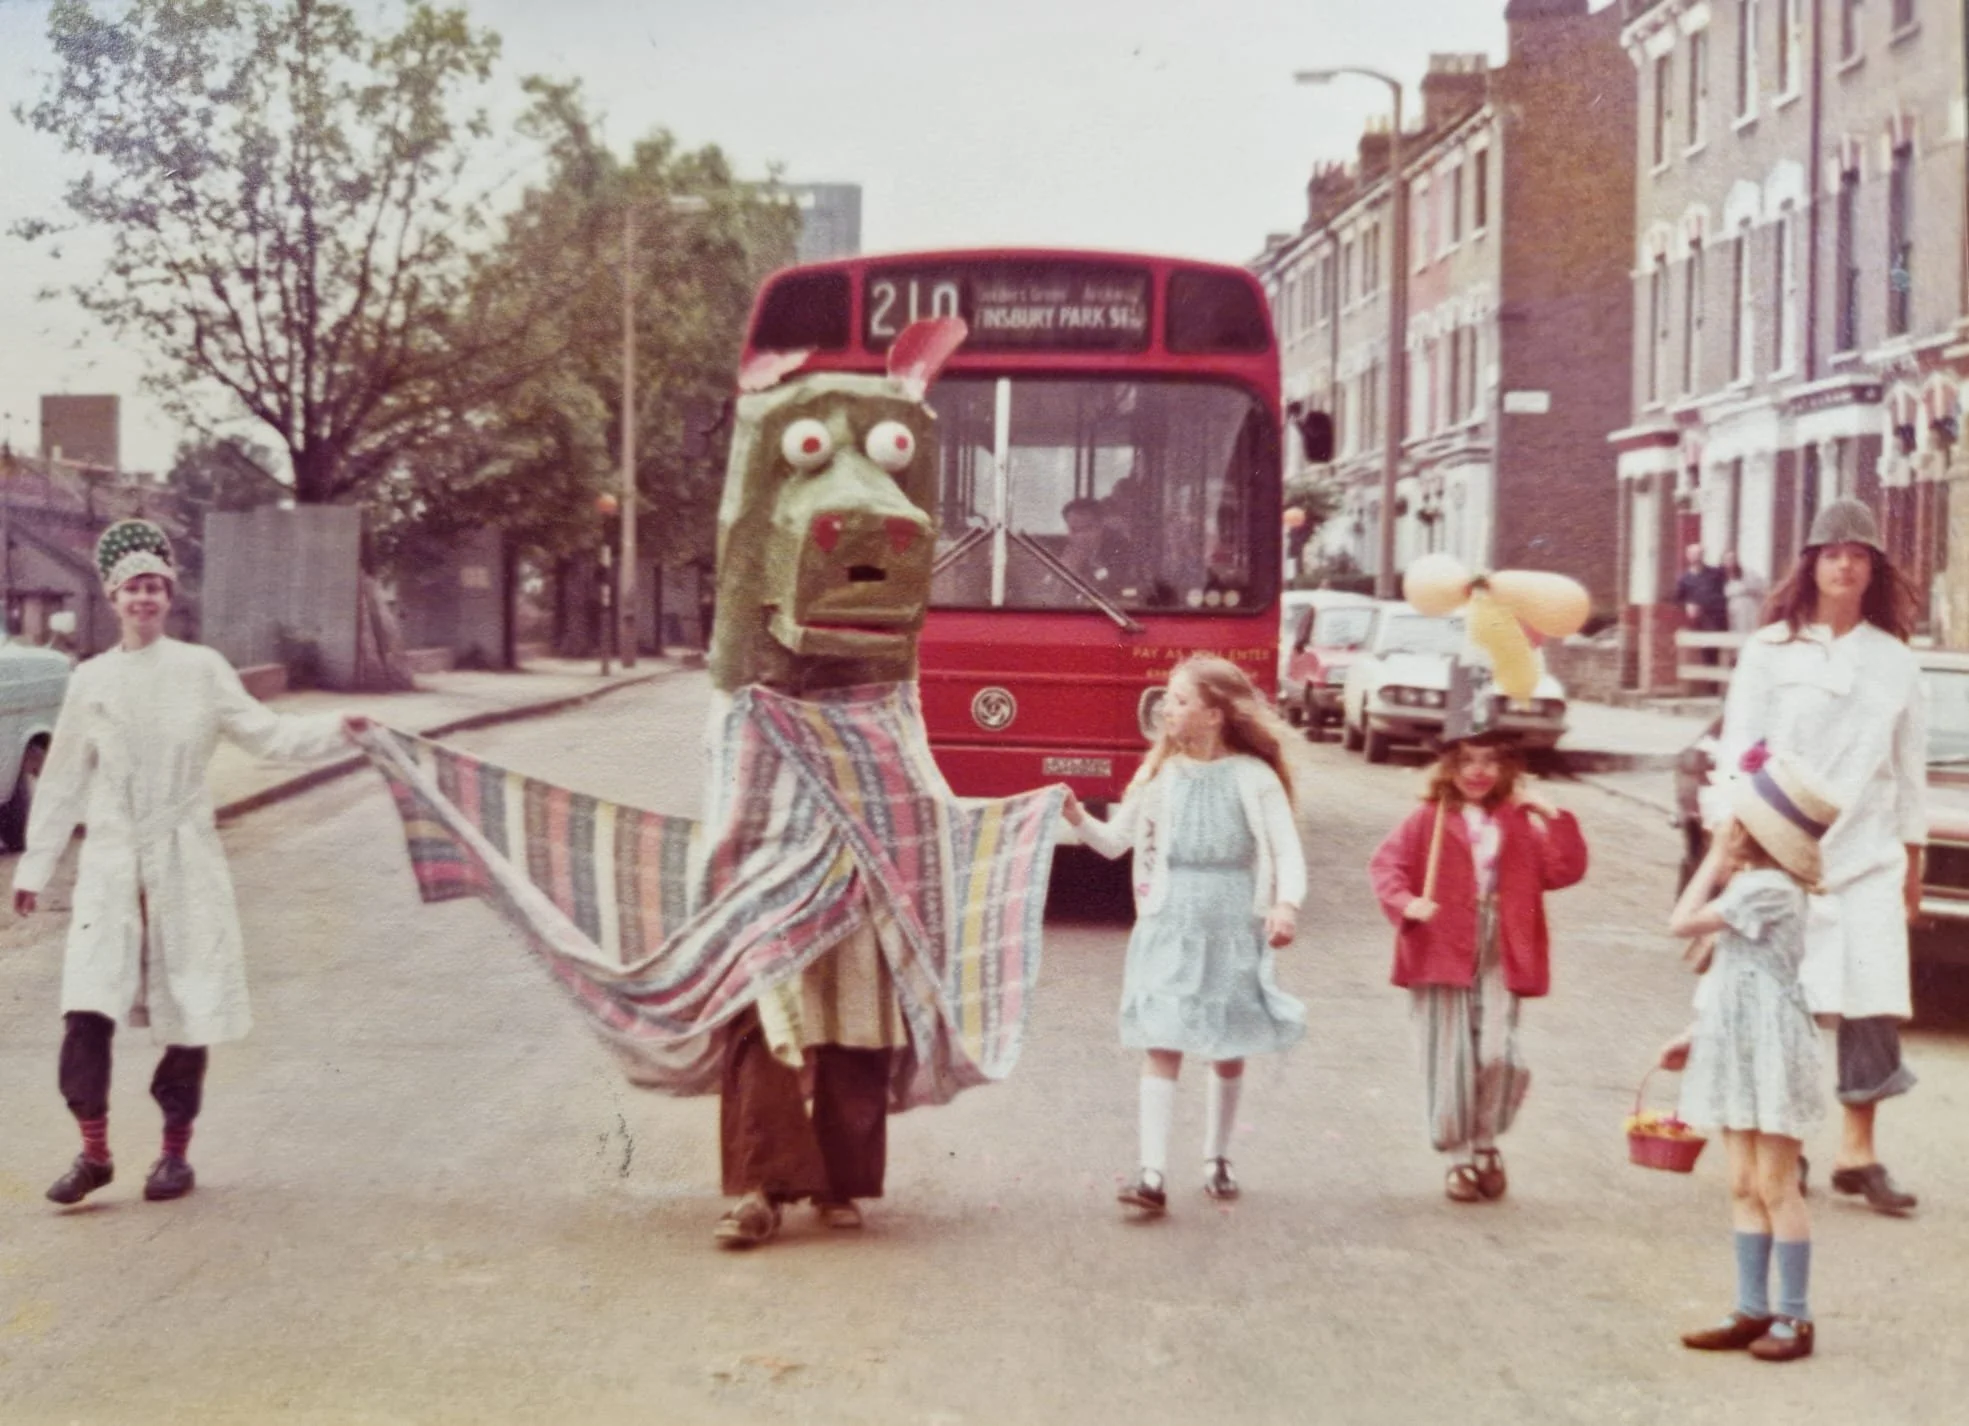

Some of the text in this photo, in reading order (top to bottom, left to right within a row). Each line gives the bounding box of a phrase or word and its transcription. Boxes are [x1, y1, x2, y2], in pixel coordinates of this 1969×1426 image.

[870, 279, 959, 337] 210
[1060, 307, 1104, 329] PARK
[1132, 647, 1158, 658] PAY
